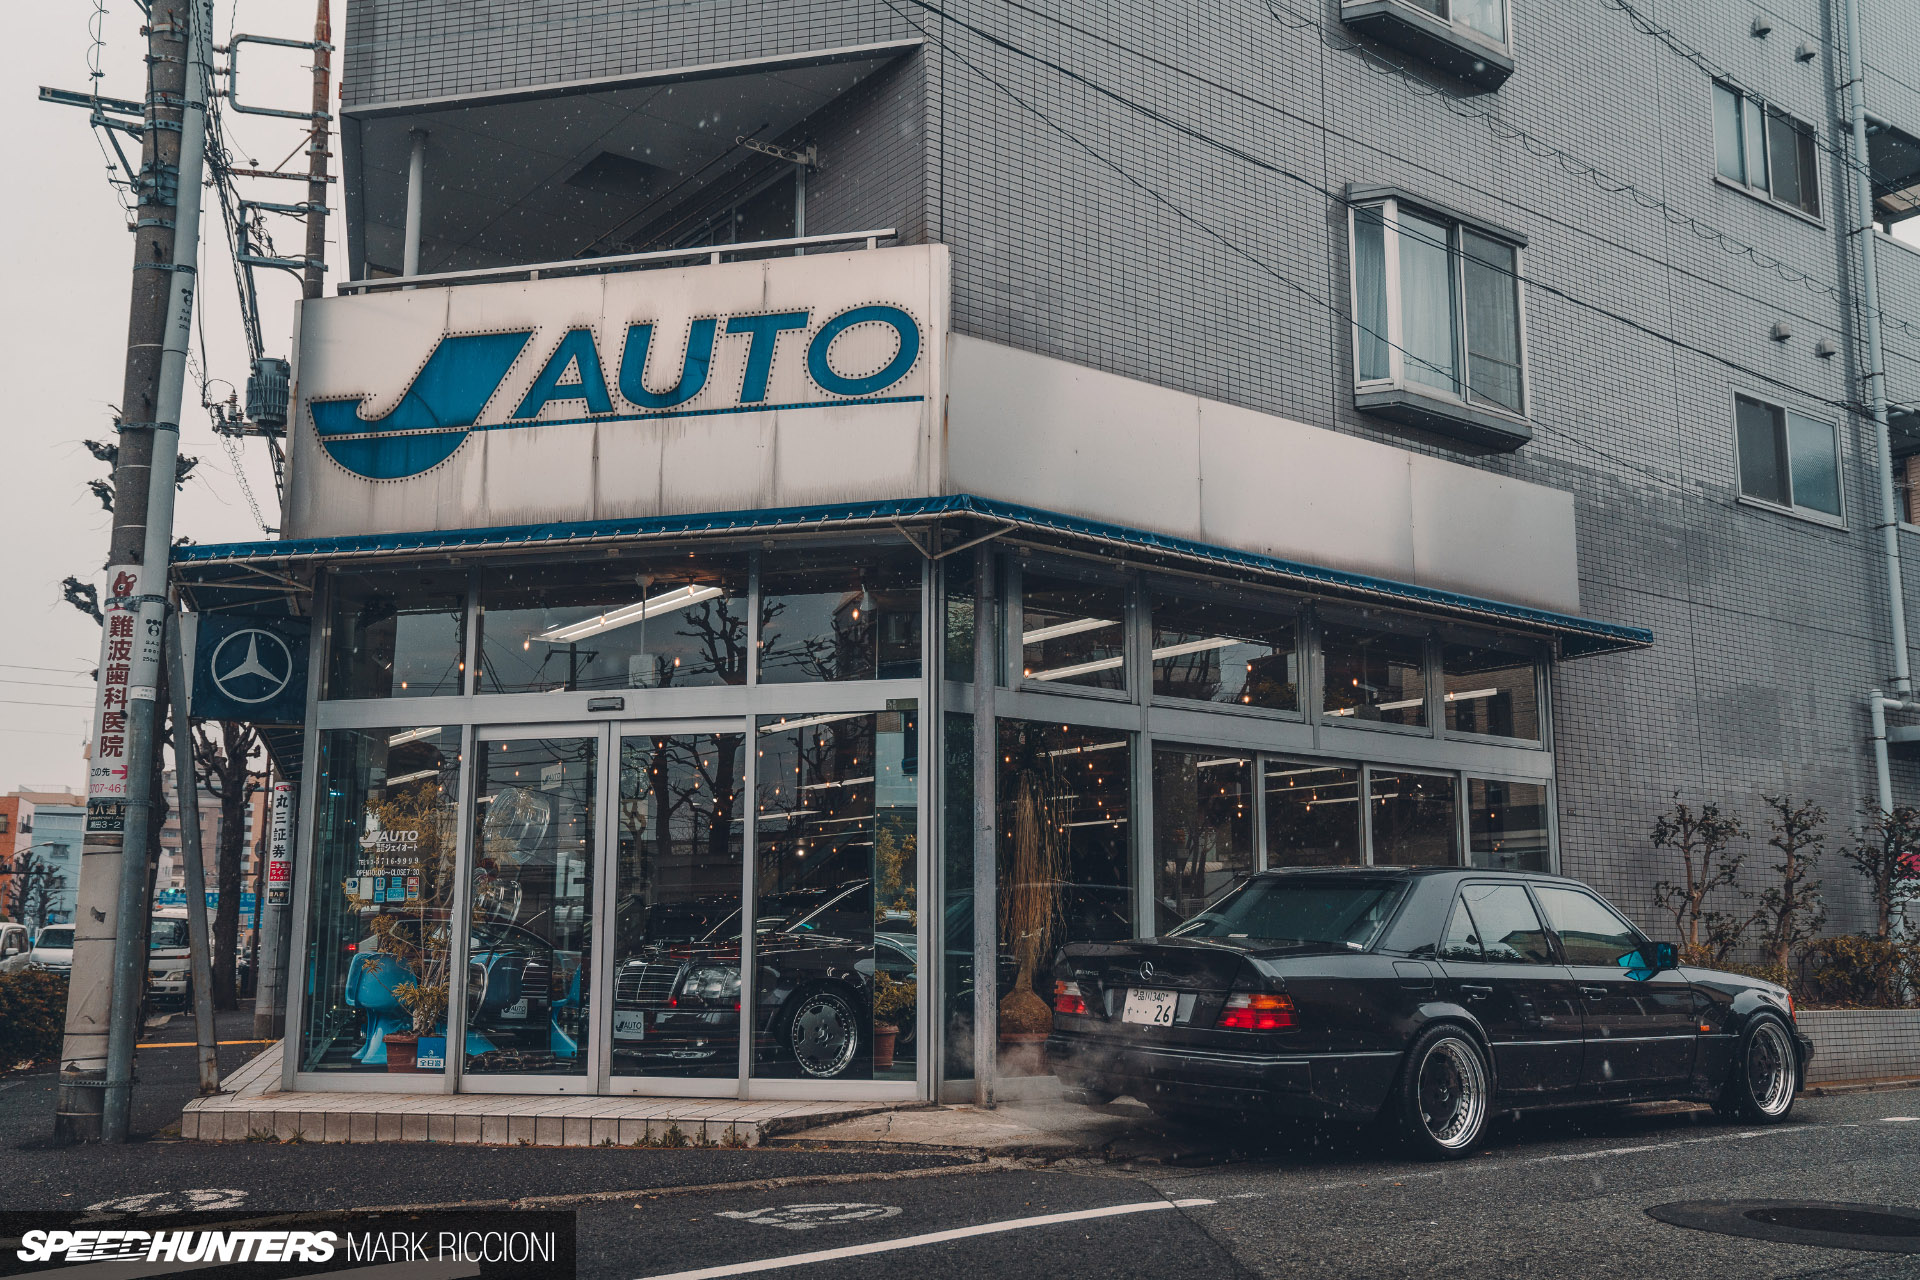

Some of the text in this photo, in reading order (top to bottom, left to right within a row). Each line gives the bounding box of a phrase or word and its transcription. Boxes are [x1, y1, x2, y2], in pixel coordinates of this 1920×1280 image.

[99, 615, 134, 758] 難波歯科医院
[91, 767, 110, 777] この先
[272, 794, 289, 859] 丸三証券
[1154, 1004, 1171, 1023] 26
